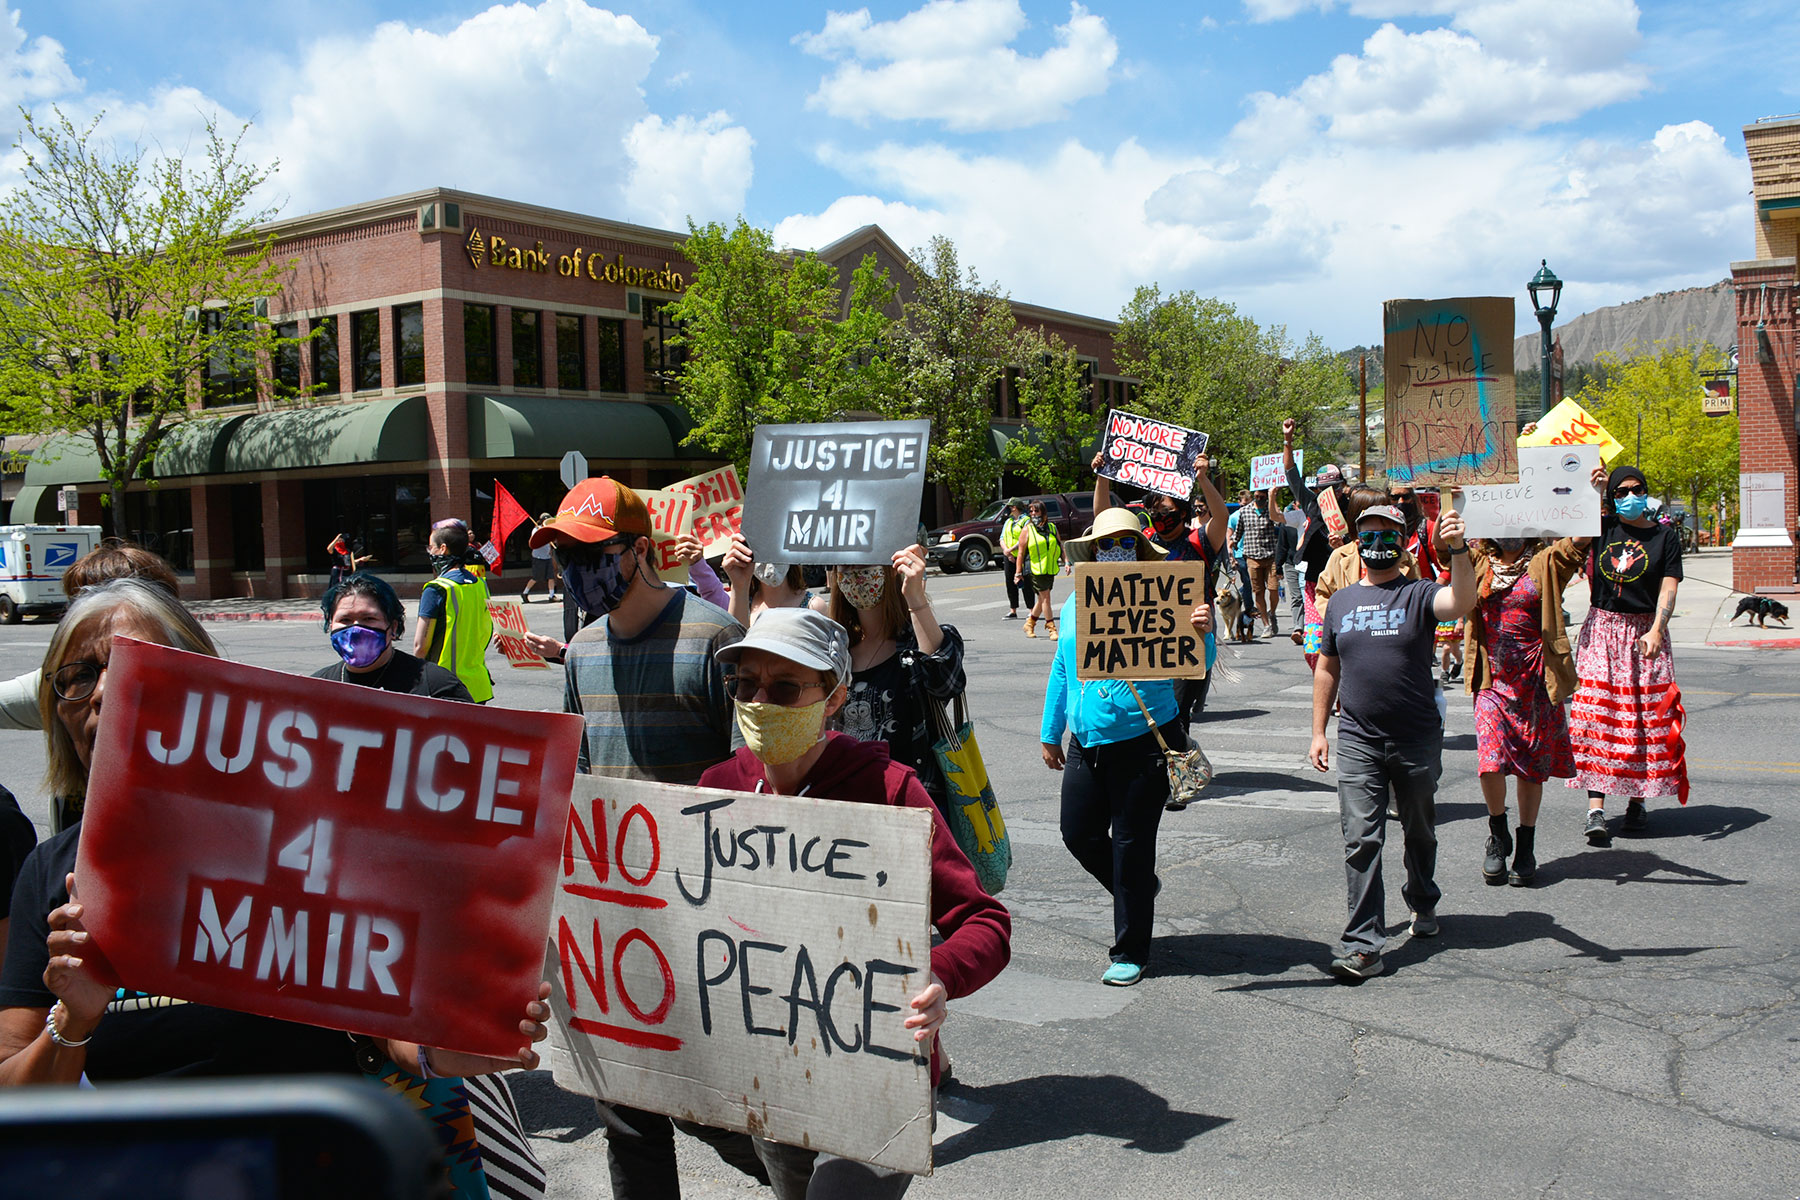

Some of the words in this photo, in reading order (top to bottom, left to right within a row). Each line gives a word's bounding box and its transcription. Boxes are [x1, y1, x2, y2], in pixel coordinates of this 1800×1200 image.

[490, 236, 551, 272] Bank
[558, 248, 582, 277] of
[587, 252, 684, 293] Colorado
[1413, 313, 1470, 359] NO
[1428, 388, 1465, 409] NO
[1704, 398, 1731, 407] PRIMI
[1111, 417, 1132, 435] NO
[1135, 421, 1185, 449] MORE
[1, 457, 27, 475] Color
[772, 437, 918, 472] JUSTICE
[1112, 439, 1175, 468] STOLEN
[1397, 420, 1519, 483] PEACE
[821, 479, 843, 510] 4
[1120, 462, 1191, 496] SISTERS
[1471, 485, 1534, 502] BELIEVE
[789, 514, 871, 547] MMIR
[1085, 573, 1195, 608] NATIVE
[1089, 608, 1176, 635] LIVES
[1083, 635, 1199, 673] MATTER
[146, 691, 531, 826] JUSTICE
[277, 818, 333, 895] 4
[562, 797, 661, 888] NO
[193, 887, 405, 997] MMIR
[558, 915, 676, 1026] NO
